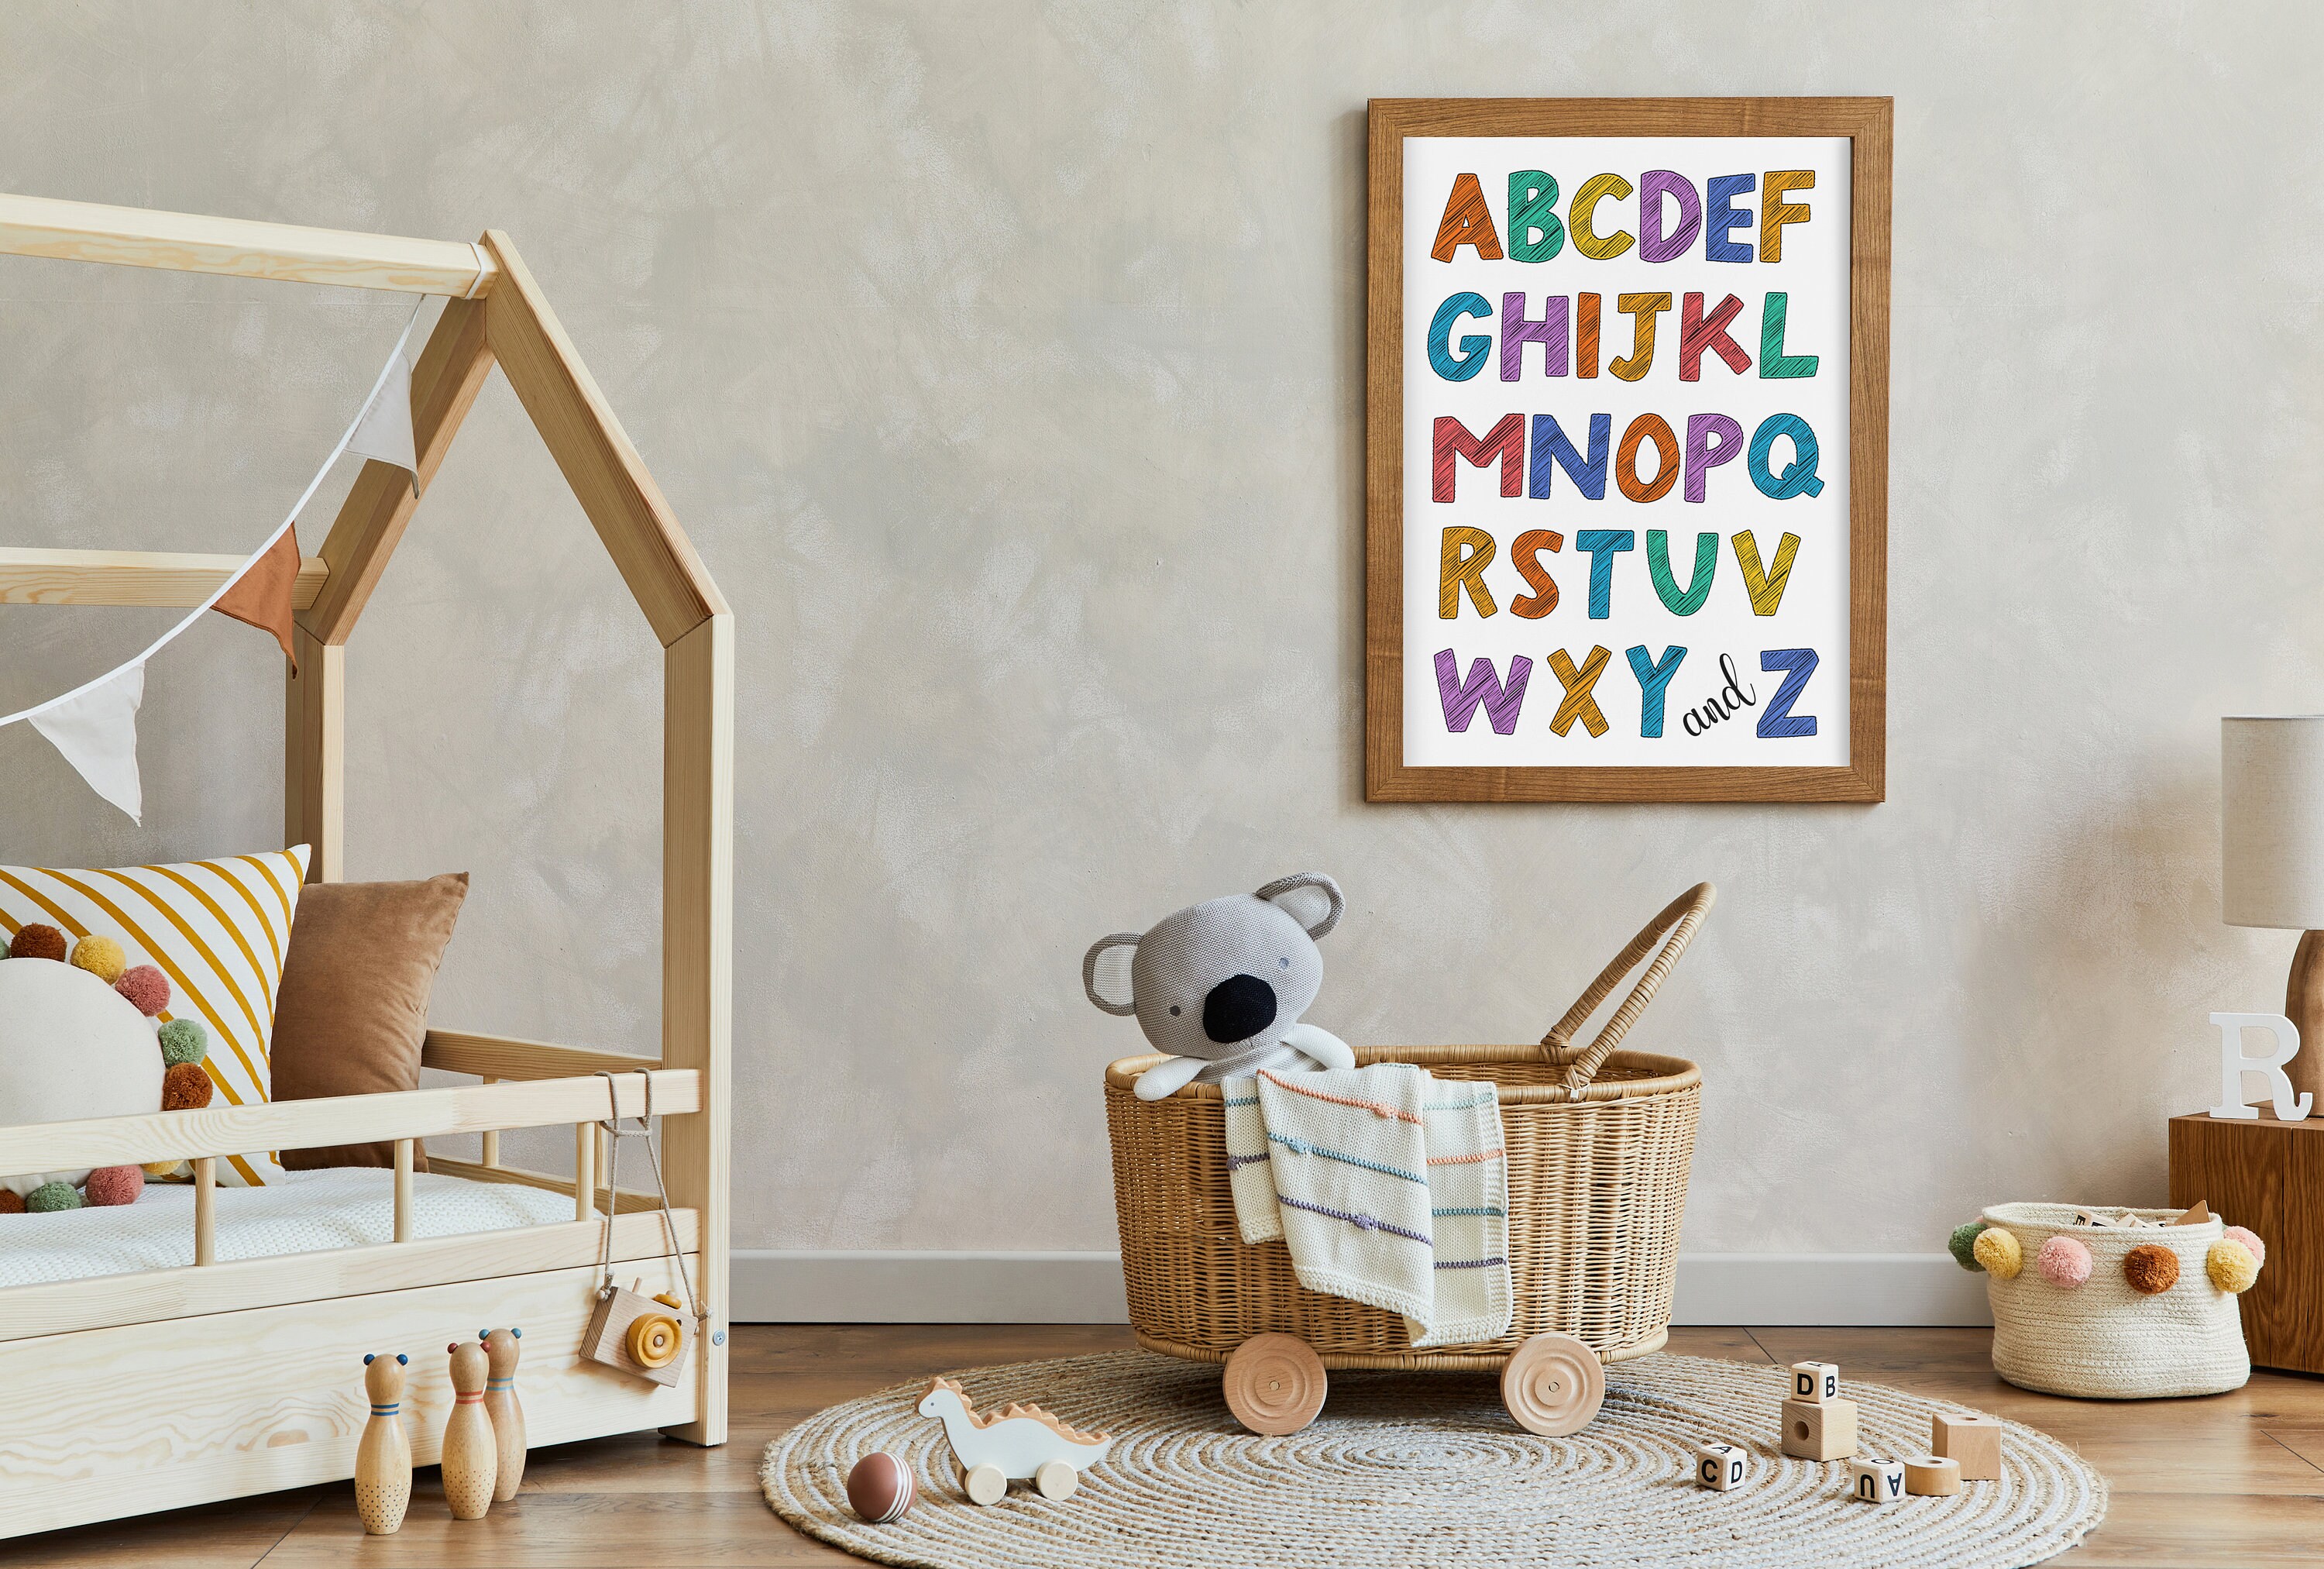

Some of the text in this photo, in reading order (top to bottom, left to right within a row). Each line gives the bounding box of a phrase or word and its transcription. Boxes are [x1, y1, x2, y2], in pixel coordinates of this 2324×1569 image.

[1430, 169, 1816, 264] ABCDEF
[1426, 291, 1820, 383] GHIJKL
[1432, 412, 1825, 504] MNOPQ
[1683, 652, 1756, 737] and
[1756, 648, 1820, 739] Z
[2209, 1012, 2313, 1121] R
[1796, 1372, 1814, 1395] D
[1825, 1375, 1836, 1398] B
[1701, 1459, 1718, 1483] C
[1731, 1461, 1743, 1484] D
[1886, 1472, 1903, 1496] A
